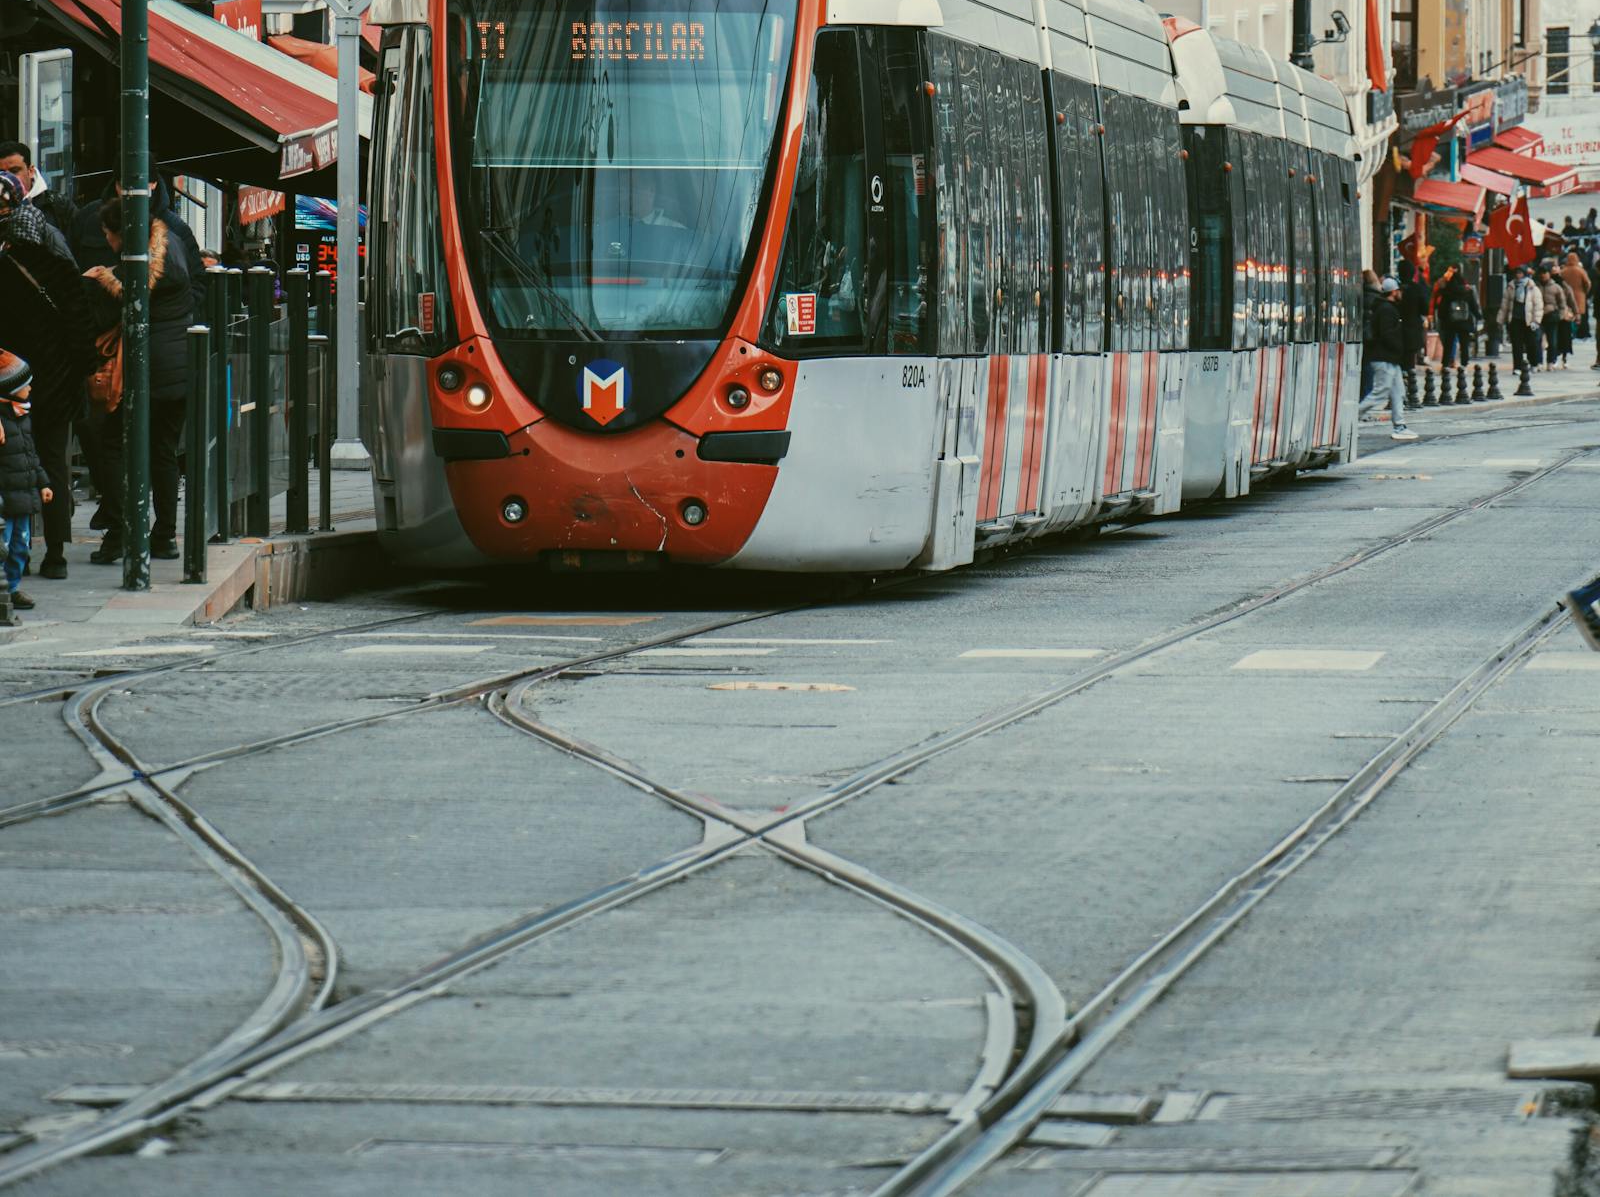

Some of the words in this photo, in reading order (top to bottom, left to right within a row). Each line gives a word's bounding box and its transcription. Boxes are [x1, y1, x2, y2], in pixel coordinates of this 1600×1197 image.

[477, 22, 505, 59] T1
[1202, 356, 1219, 371] 837B
[902, 365, 925, 388] 820A
